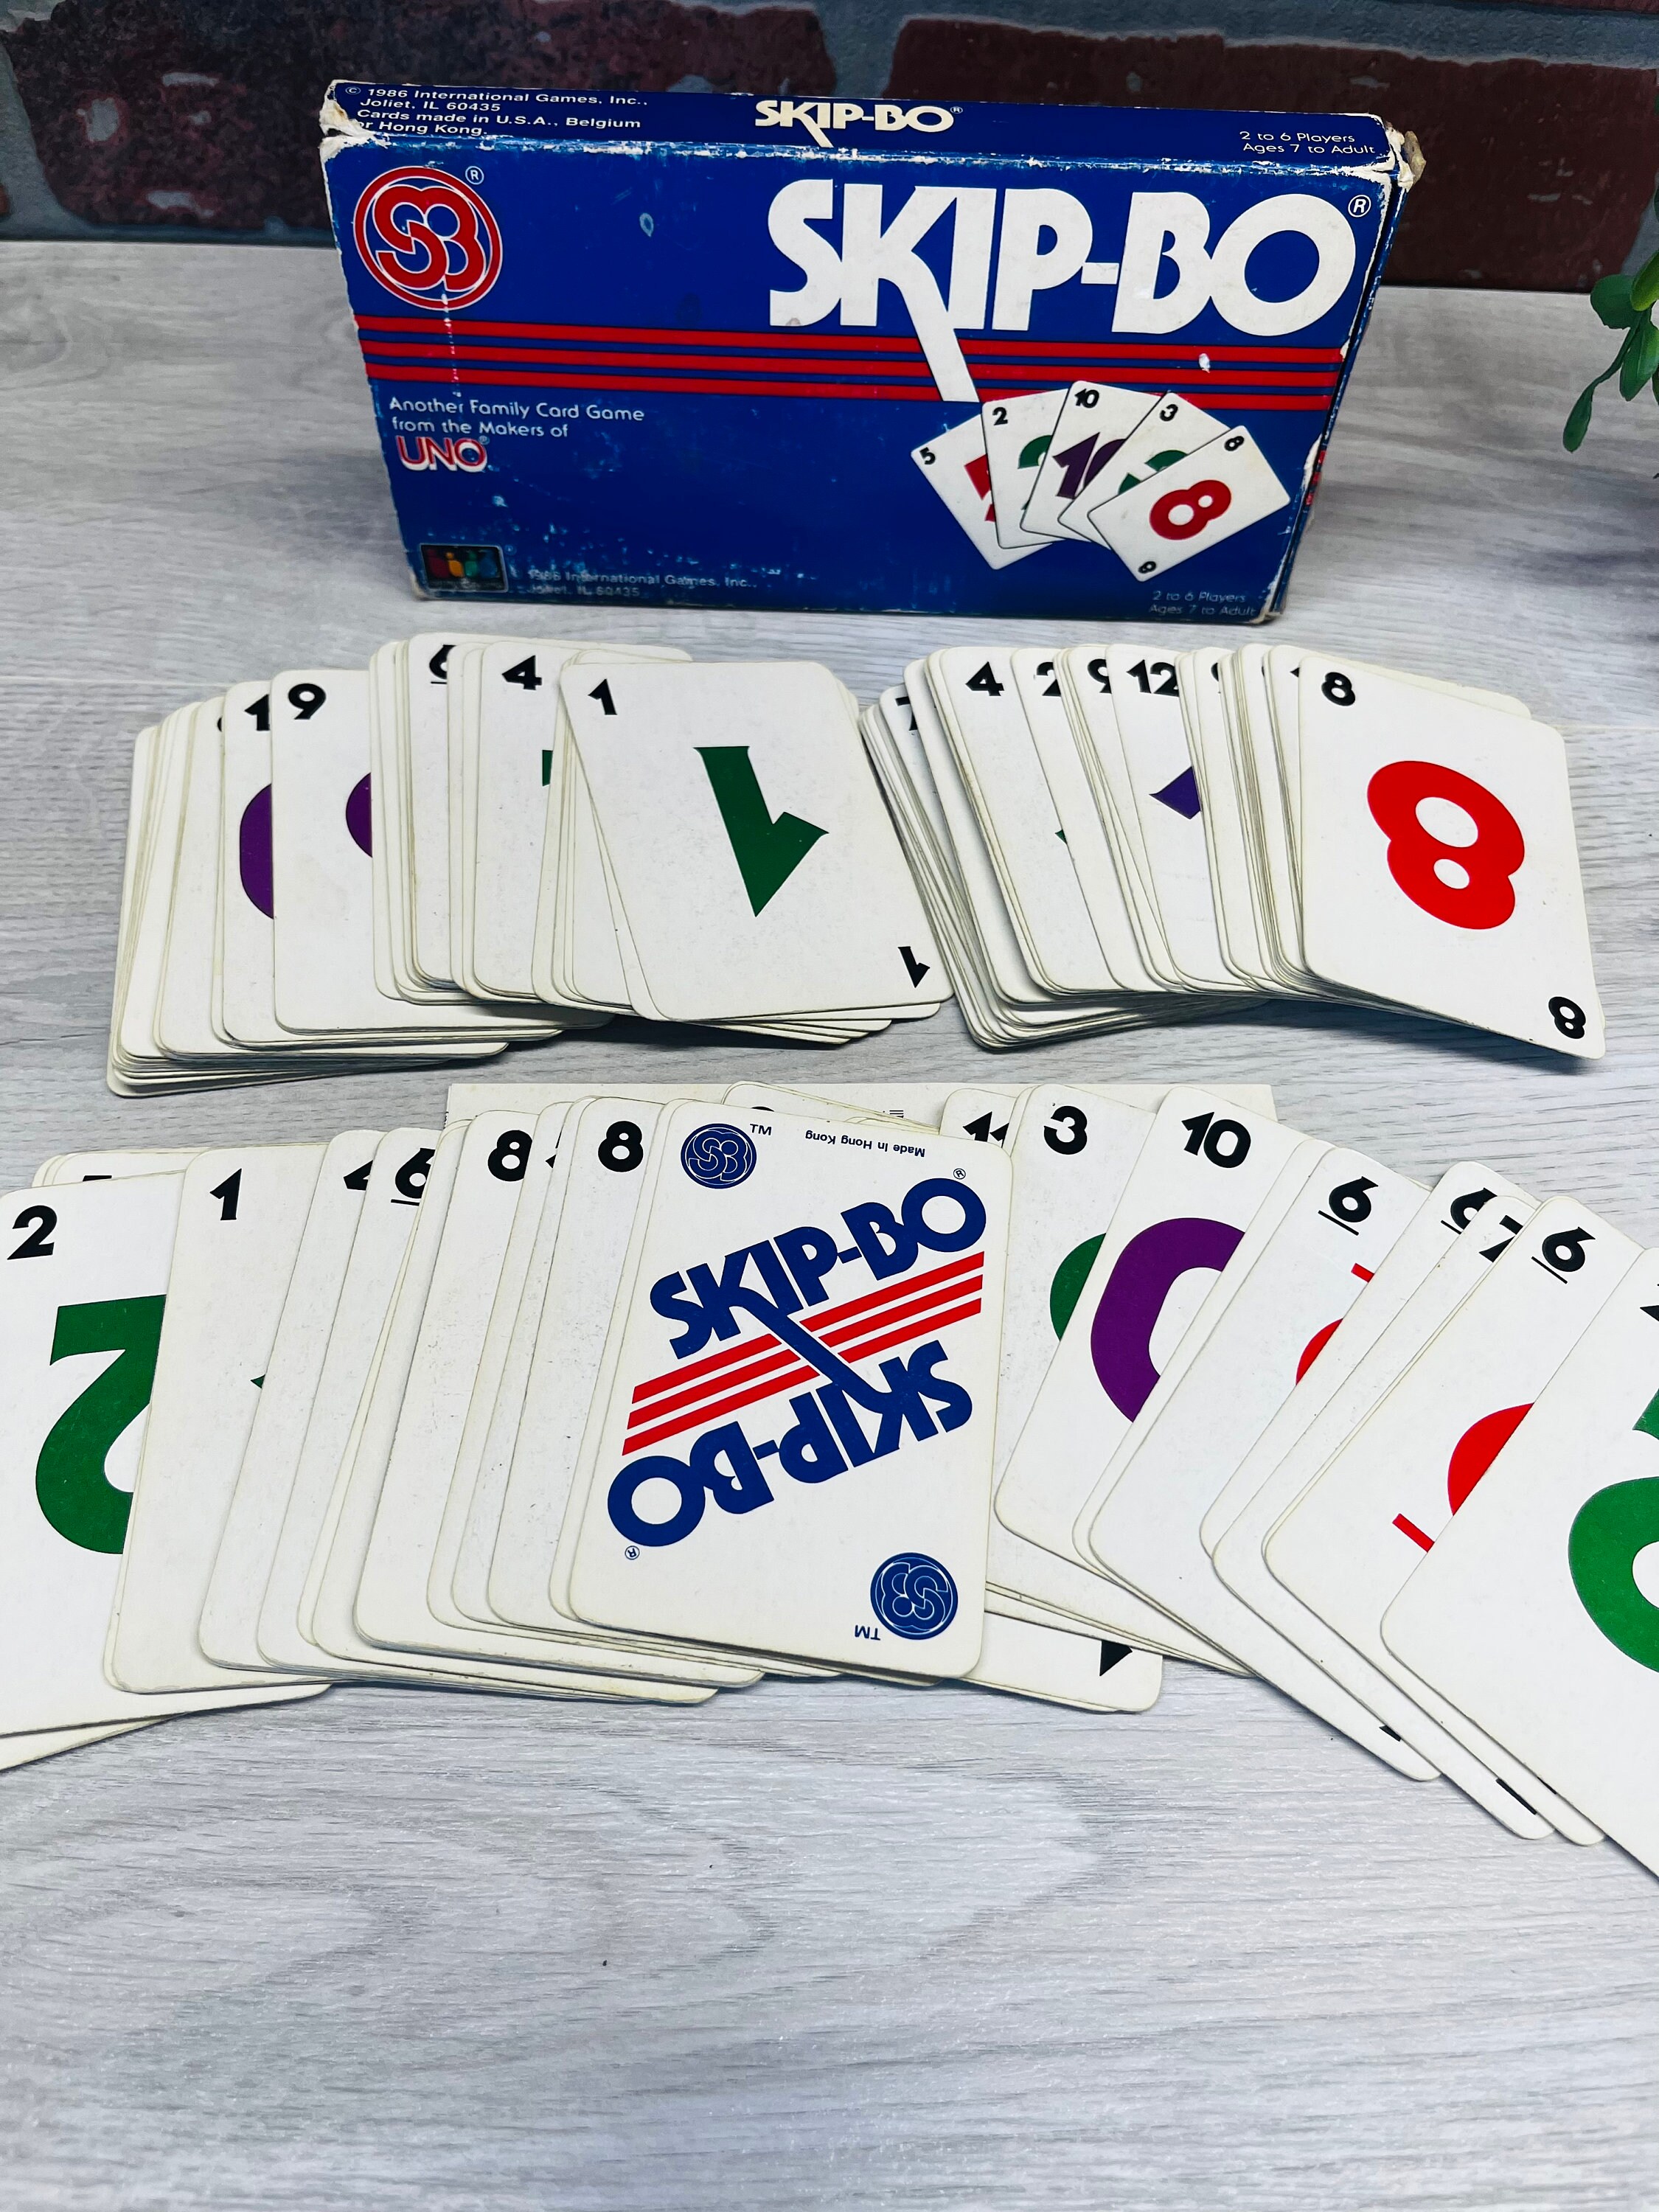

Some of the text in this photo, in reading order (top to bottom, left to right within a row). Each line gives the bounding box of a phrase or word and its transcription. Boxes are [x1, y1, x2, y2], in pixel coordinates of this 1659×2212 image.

[369, 88, 408, 97] 1986
[414, 90, 529, 102] International
[423, 101, 439, 110] IL
[447, 102, 501, 111] 60435
[357, 109, 410, 120] Cards
[416, 112, 466, 122] made
[473, 114, 489, 123] in
[566, 117, 641, 129] Belgium
[378, 121, 428, 134] Hong
[435, 124, 487, 136] Kong.
[755, 100, 954, 147] SKIP-BO
[1239, 131, 1355, 143] 2 to 6 Players
[1243, 142, 1376, 154] Ages 7 to Adult
[768, 178, 1357, 403] SKIP-BO
[389, 397, 644, 421] Another Family Card Game
[992, 407, 1008, 425] 2
[1074, 388, 1100, 408] 10
[1159, 403, 1179, 421] 3
[392, 416, 568, 437] from the Makers of
[1224, 435, 1245, 451] 8
[395, 434, 487, 473] UNO
[920, 448, 936, 465] 5
[1150, 479, 1232, 540] 8
[1138, 560, 1157, 574] 8
[1149, 604, 1183, 616] Ages
[1202, 607, 1215, 615] to
[1219, 606, 1256, 616] Adult
[1152, 591, 1246, 603] 2 to 6 Players
[501, 655, 543, 690] 4
[965, 661, 1005, 697] 4
[1036, 661, 1062, 697] 2
[1087, 658, 1112, 694] 9
[1126, 659, 1180, 697] 12
[1321, 672, 1356, 706] 8
[288, 683, 327, 720] 9
[588, 678, 618, 716] 1
[693, 745, 830, 919] 1
[1367, 760, 1525, 930] 8
[897, 945, 931, 989] 1
[1548, 996, 1586, 1040] 8
[597, 1121, 644, 1173] 8
[805, 1129, 926, 1158] Made In Hong Kong
[1043, 1105, 1088, 1155] 3
[1181, 1111, 1251, 1169] 10
[487, 1130, 532, 1182] 8
[209, 1168, 243, 1221] 1
[391, 1147, 436, 1206] 6
[1318, 1175, 1380, 1236] 6
[7, 1205, 58, 1260] 2
[1531, 1226, 1596, 1284] 6
[649, 1177, 987, 1386] SKIP-BO
[607, 1339, 973, 1548] SKIP-BO
